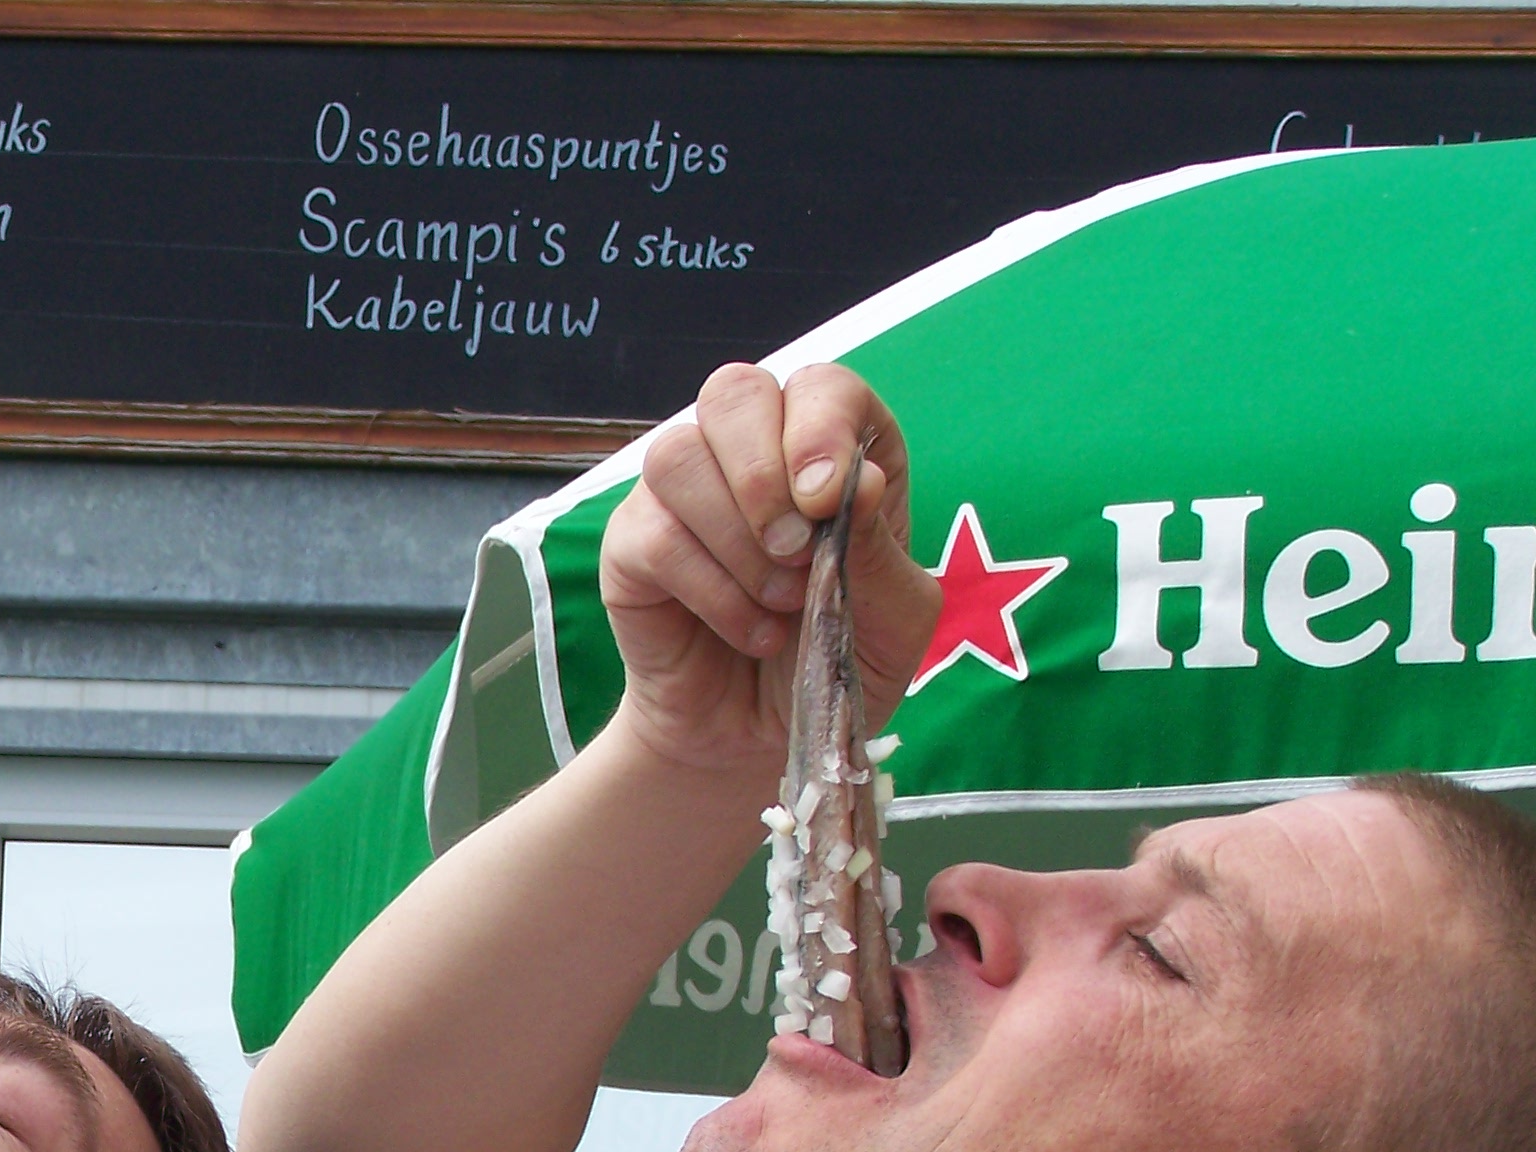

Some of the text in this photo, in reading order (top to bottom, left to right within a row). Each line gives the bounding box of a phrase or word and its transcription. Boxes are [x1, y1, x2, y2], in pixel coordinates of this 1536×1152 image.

[315, 102, 728, 192] Ossehaaspuntjes
[299, 187, 755, 280] Scampi's 6 stuks
[306, 274, 600, 357] Kabeljauw
